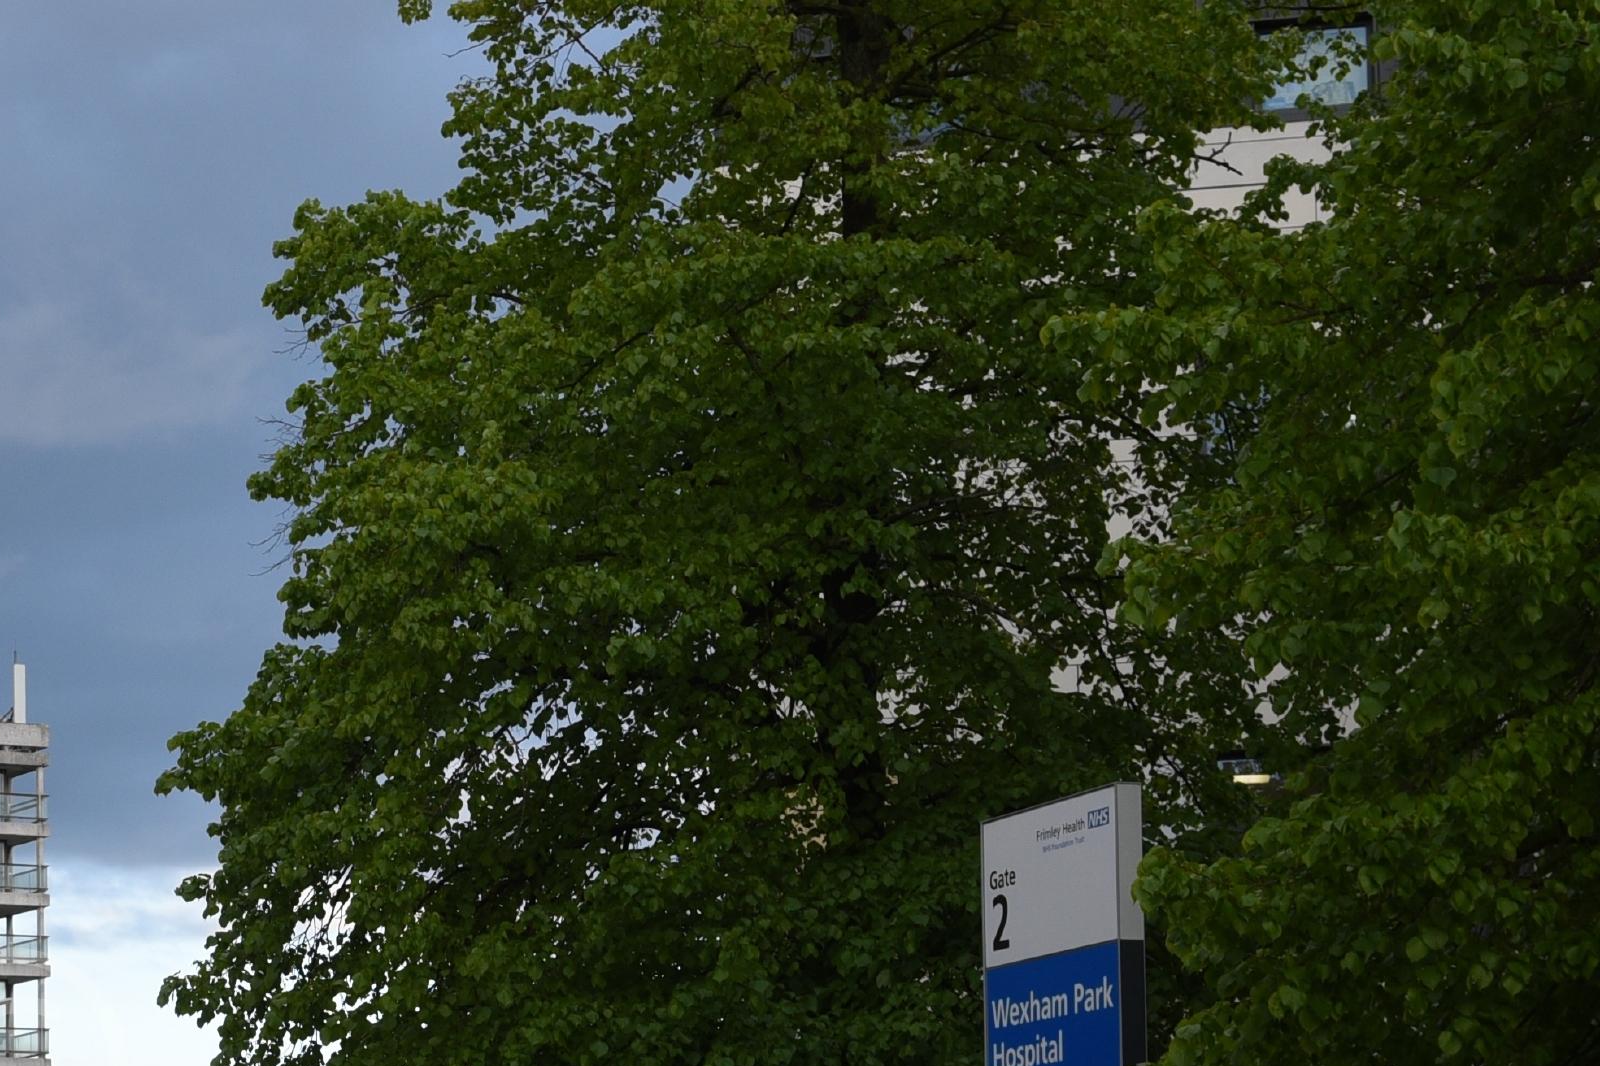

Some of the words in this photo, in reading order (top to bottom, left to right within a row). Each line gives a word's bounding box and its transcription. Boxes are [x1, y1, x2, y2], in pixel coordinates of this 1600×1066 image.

[1036, 827, 1061, 842] Frimley
[1062, 818, 1085, 835] Health
[1088, 808, 1109, 828] NHS
[989, 868, 1016, 890] Gate
[992, 894, 1010, 952] 2
[991, 990, 1068, 1029] Wexham
[1073, 975, 1114, 1015] Park
